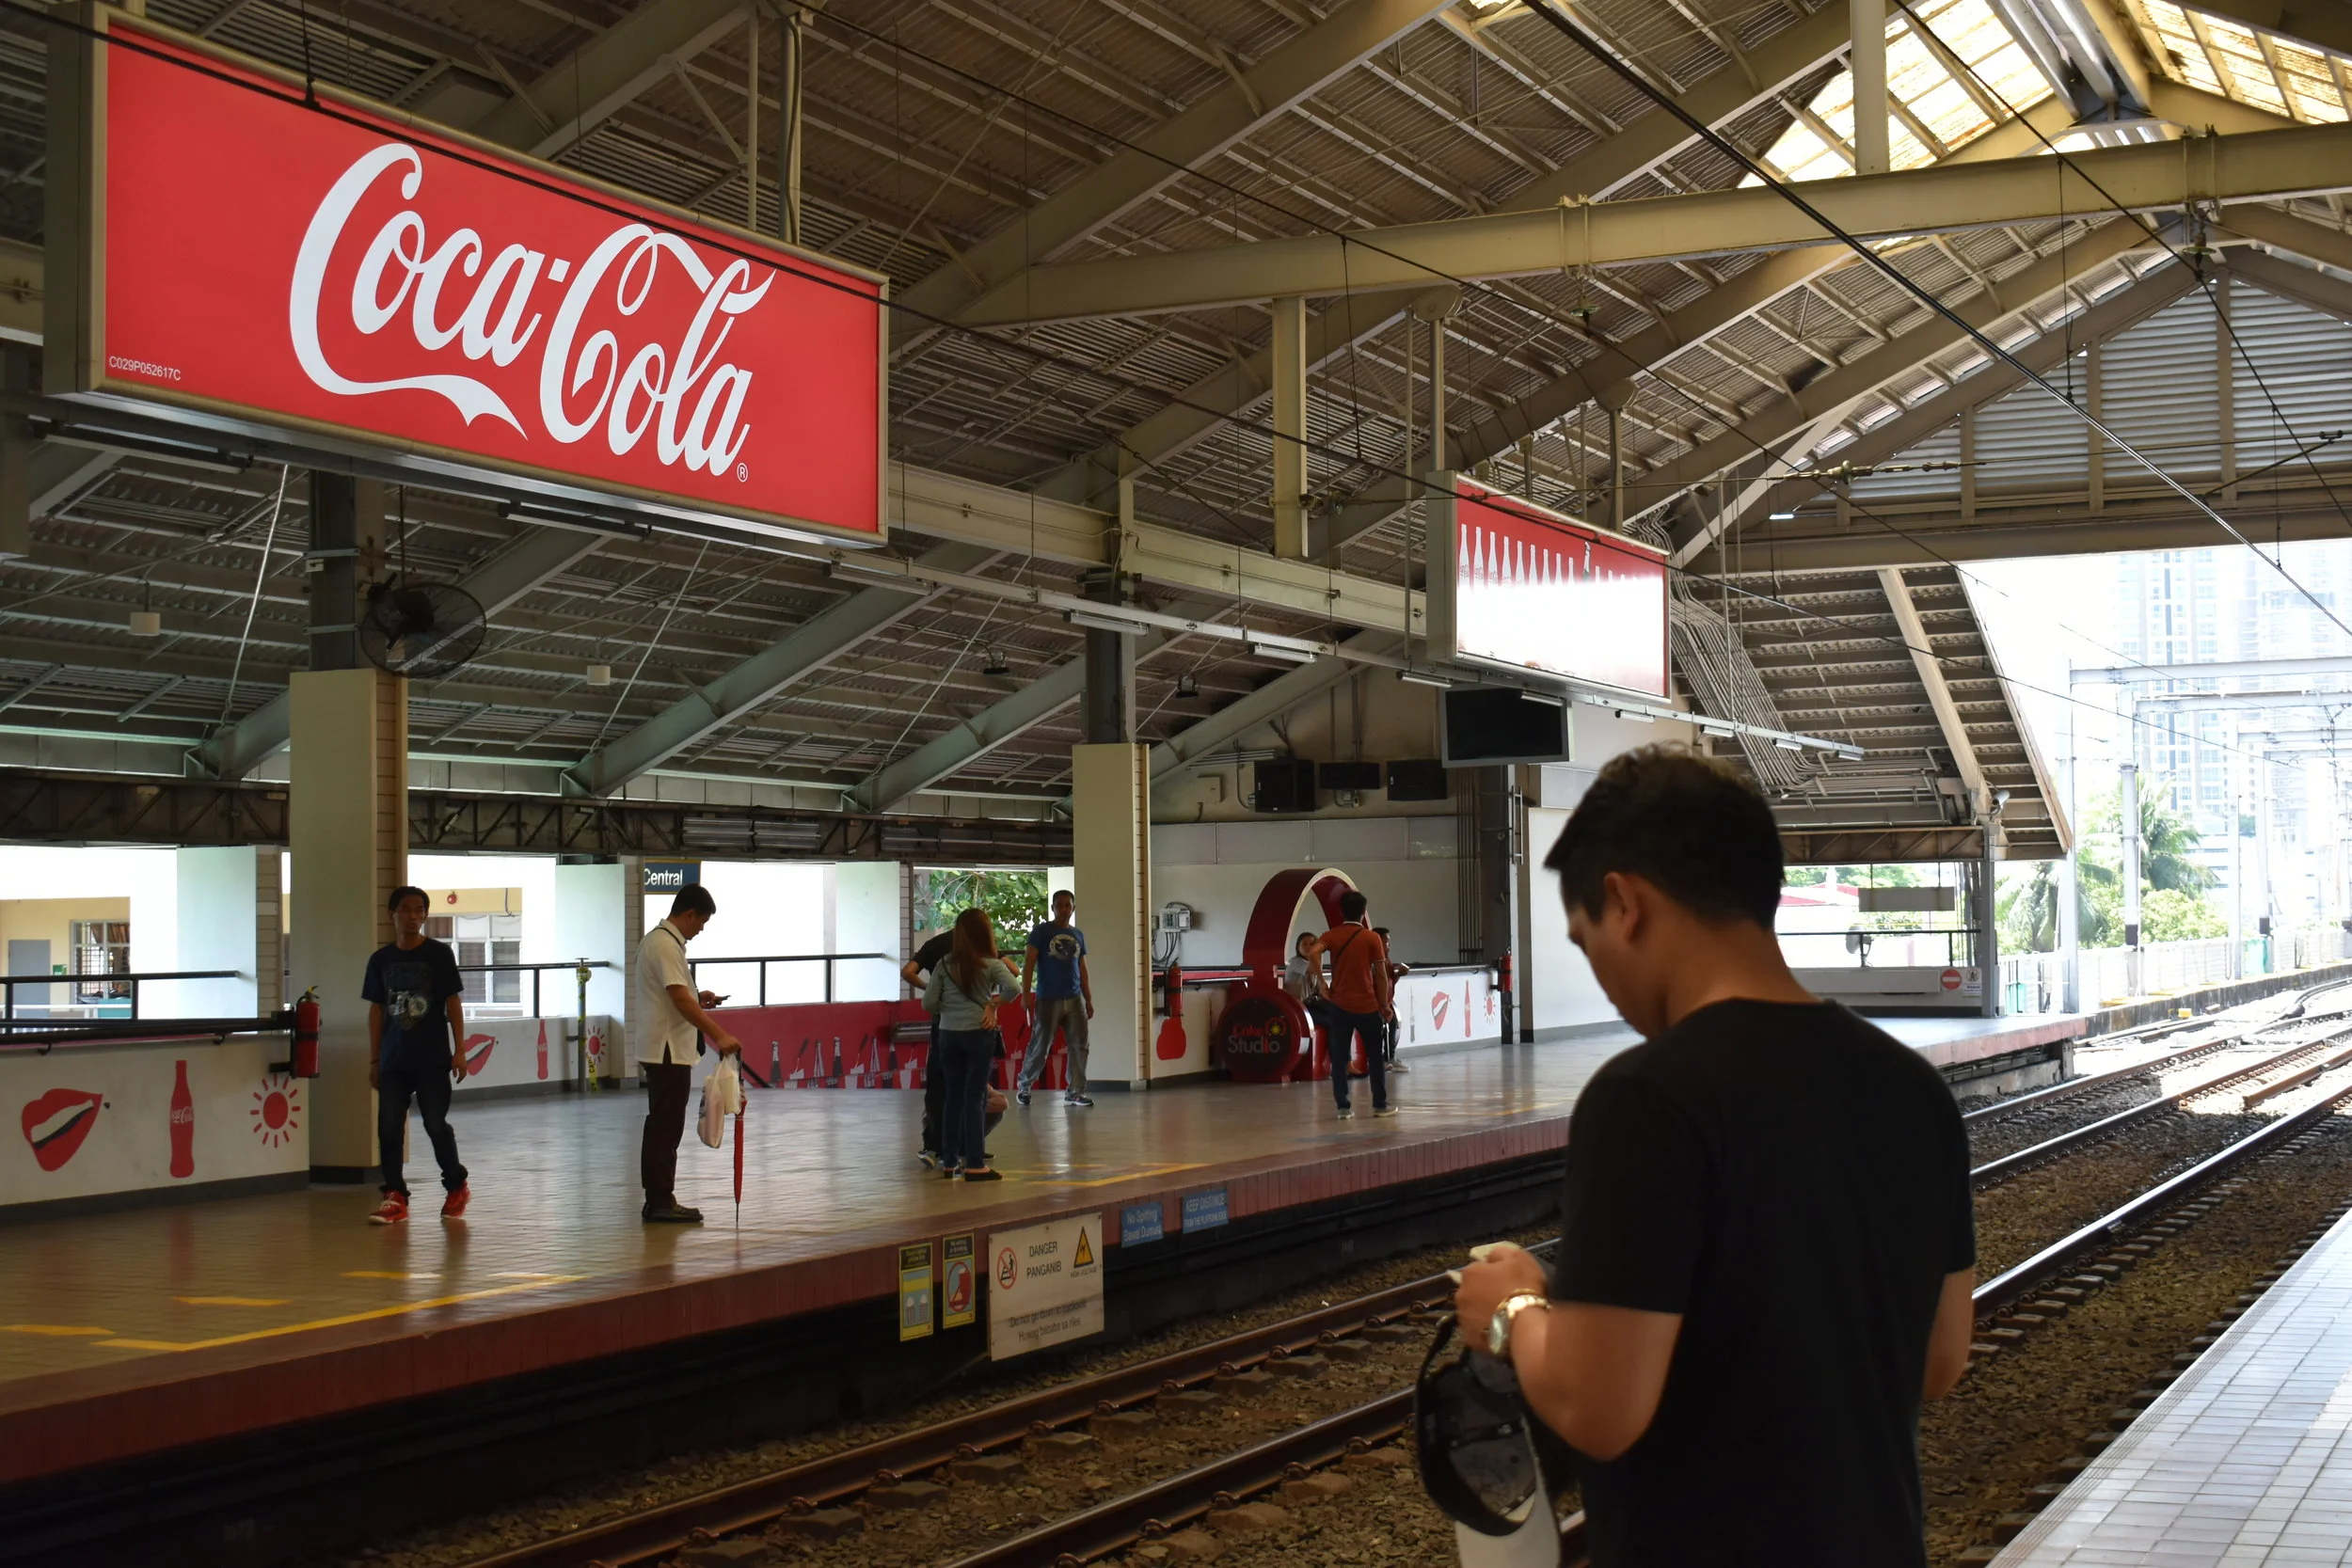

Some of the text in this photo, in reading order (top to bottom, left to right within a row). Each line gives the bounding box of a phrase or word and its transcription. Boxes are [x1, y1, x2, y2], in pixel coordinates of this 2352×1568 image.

[290, 143, 775, 476] Coca-Cola
[109, 356, 181, 381] C029P052617C
[644, 868, 683, 885] Central
[1228, 1035, 1280, 1053] Studio
[1029, 1241, 1057, 1258] DANGER
[1026, 1260, 1062, 1279] PANGANIB
